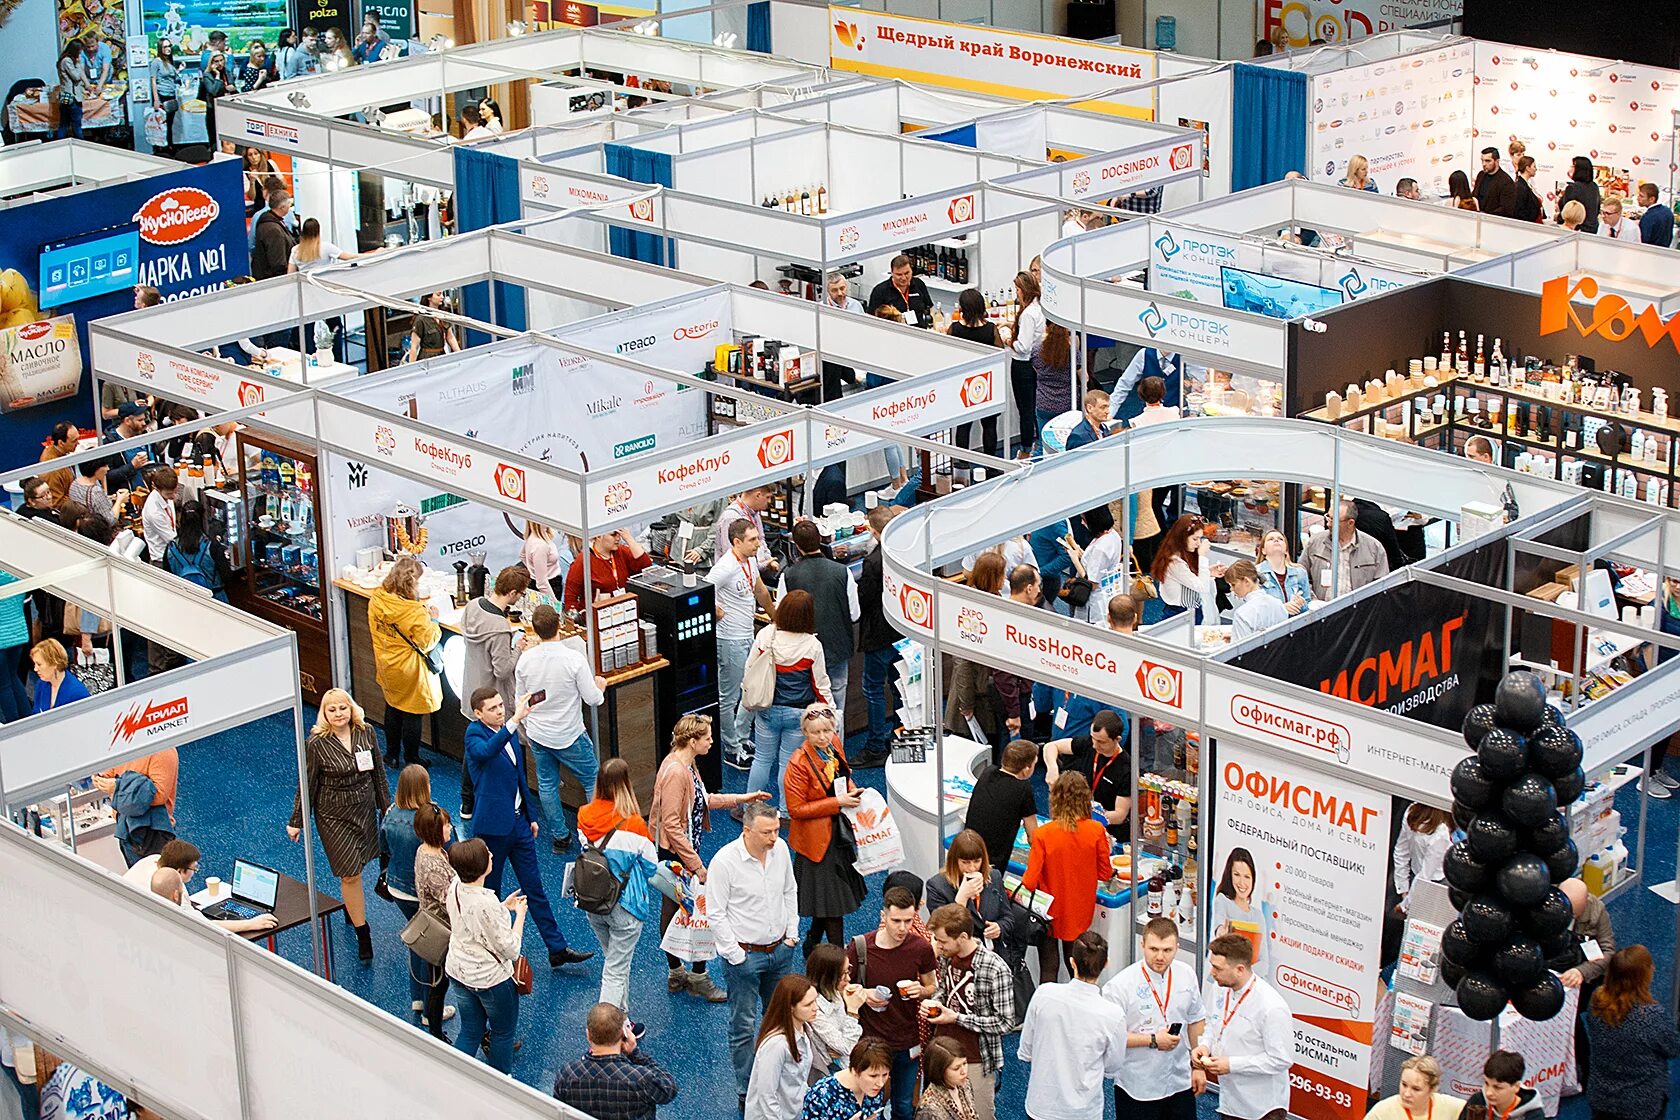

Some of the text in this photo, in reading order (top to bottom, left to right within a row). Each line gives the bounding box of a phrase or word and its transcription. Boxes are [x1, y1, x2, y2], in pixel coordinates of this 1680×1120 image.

[309, 8, 338, 20] polza
[876, 25, 1142, 79] Щедрый край Воронежский
[1101, 156, 1160, 180] DOCSINBOX
[568, 186, 609, 201] MIXOMANIA
[882, 212, 928, 232] MIXOMANIA
[199, 243, 226, 276] №1
[1183, 239, 1236, 260] ПРОТЭК
[1371, 277, 1405, 292] ПРО
[1170, 312, 1229, 337] ПРОТЭК
[1170, 328, 1230, 348] КОНЦЕРН
[11, 339, 65, 365] МАСЛО
[439, 380, 488, 401] ALTHAUS
[872, 389, 937, 421] КофеКлуб
[414, 437, 472, 469] КофеКлуб
[827, 436, 847, 449] SHOW
[657, 451, 731, 485] КофеКлуб
[608, 480, 628, 494] EXPO
[607, 502, 629, 516] SHOW
[961, 606, 984, 621] EXPO
[960, 630, 984, 644] SHOW
[1005, 624, 1118, 674] RussHoReCa
[1040, 657, 1061, 671] Стенд
[146, 702, 187, 723] ТРИАЛ
[146, 715, 190, 737] МАРКЕТ
[1240, 704, 1340, 748] офисмаг.рф
[1224, 761, 1378, 836] ОФИСМАГ
[1223, 790, 1376, 851] ДЛЯ ОФИСА, ДОМА И СЕМЬИ
[1227, 818, 1366, 876] ФЕДЕРАЛЬНЫЙ ПОСТАВЩИК!
[1285, 864, 1335, 889] 20 000 товаров
[1283, 885, 1373, 922] Удобный интернет-магазин
[1288, 897, 1326, 916] бесплатной
[1327, 911, 1361, 929] доставкой
[1281, 913, 1364, 952] Персональный менеджер
[1279, 935, 1302, 949] АКЦИИ
[1302, 943, 1334, 963] ПОДАРКИ
[1283, 972, 1354, 1006] офисмаг.рф
[1305, 1034, 1358, 1062] остальном
